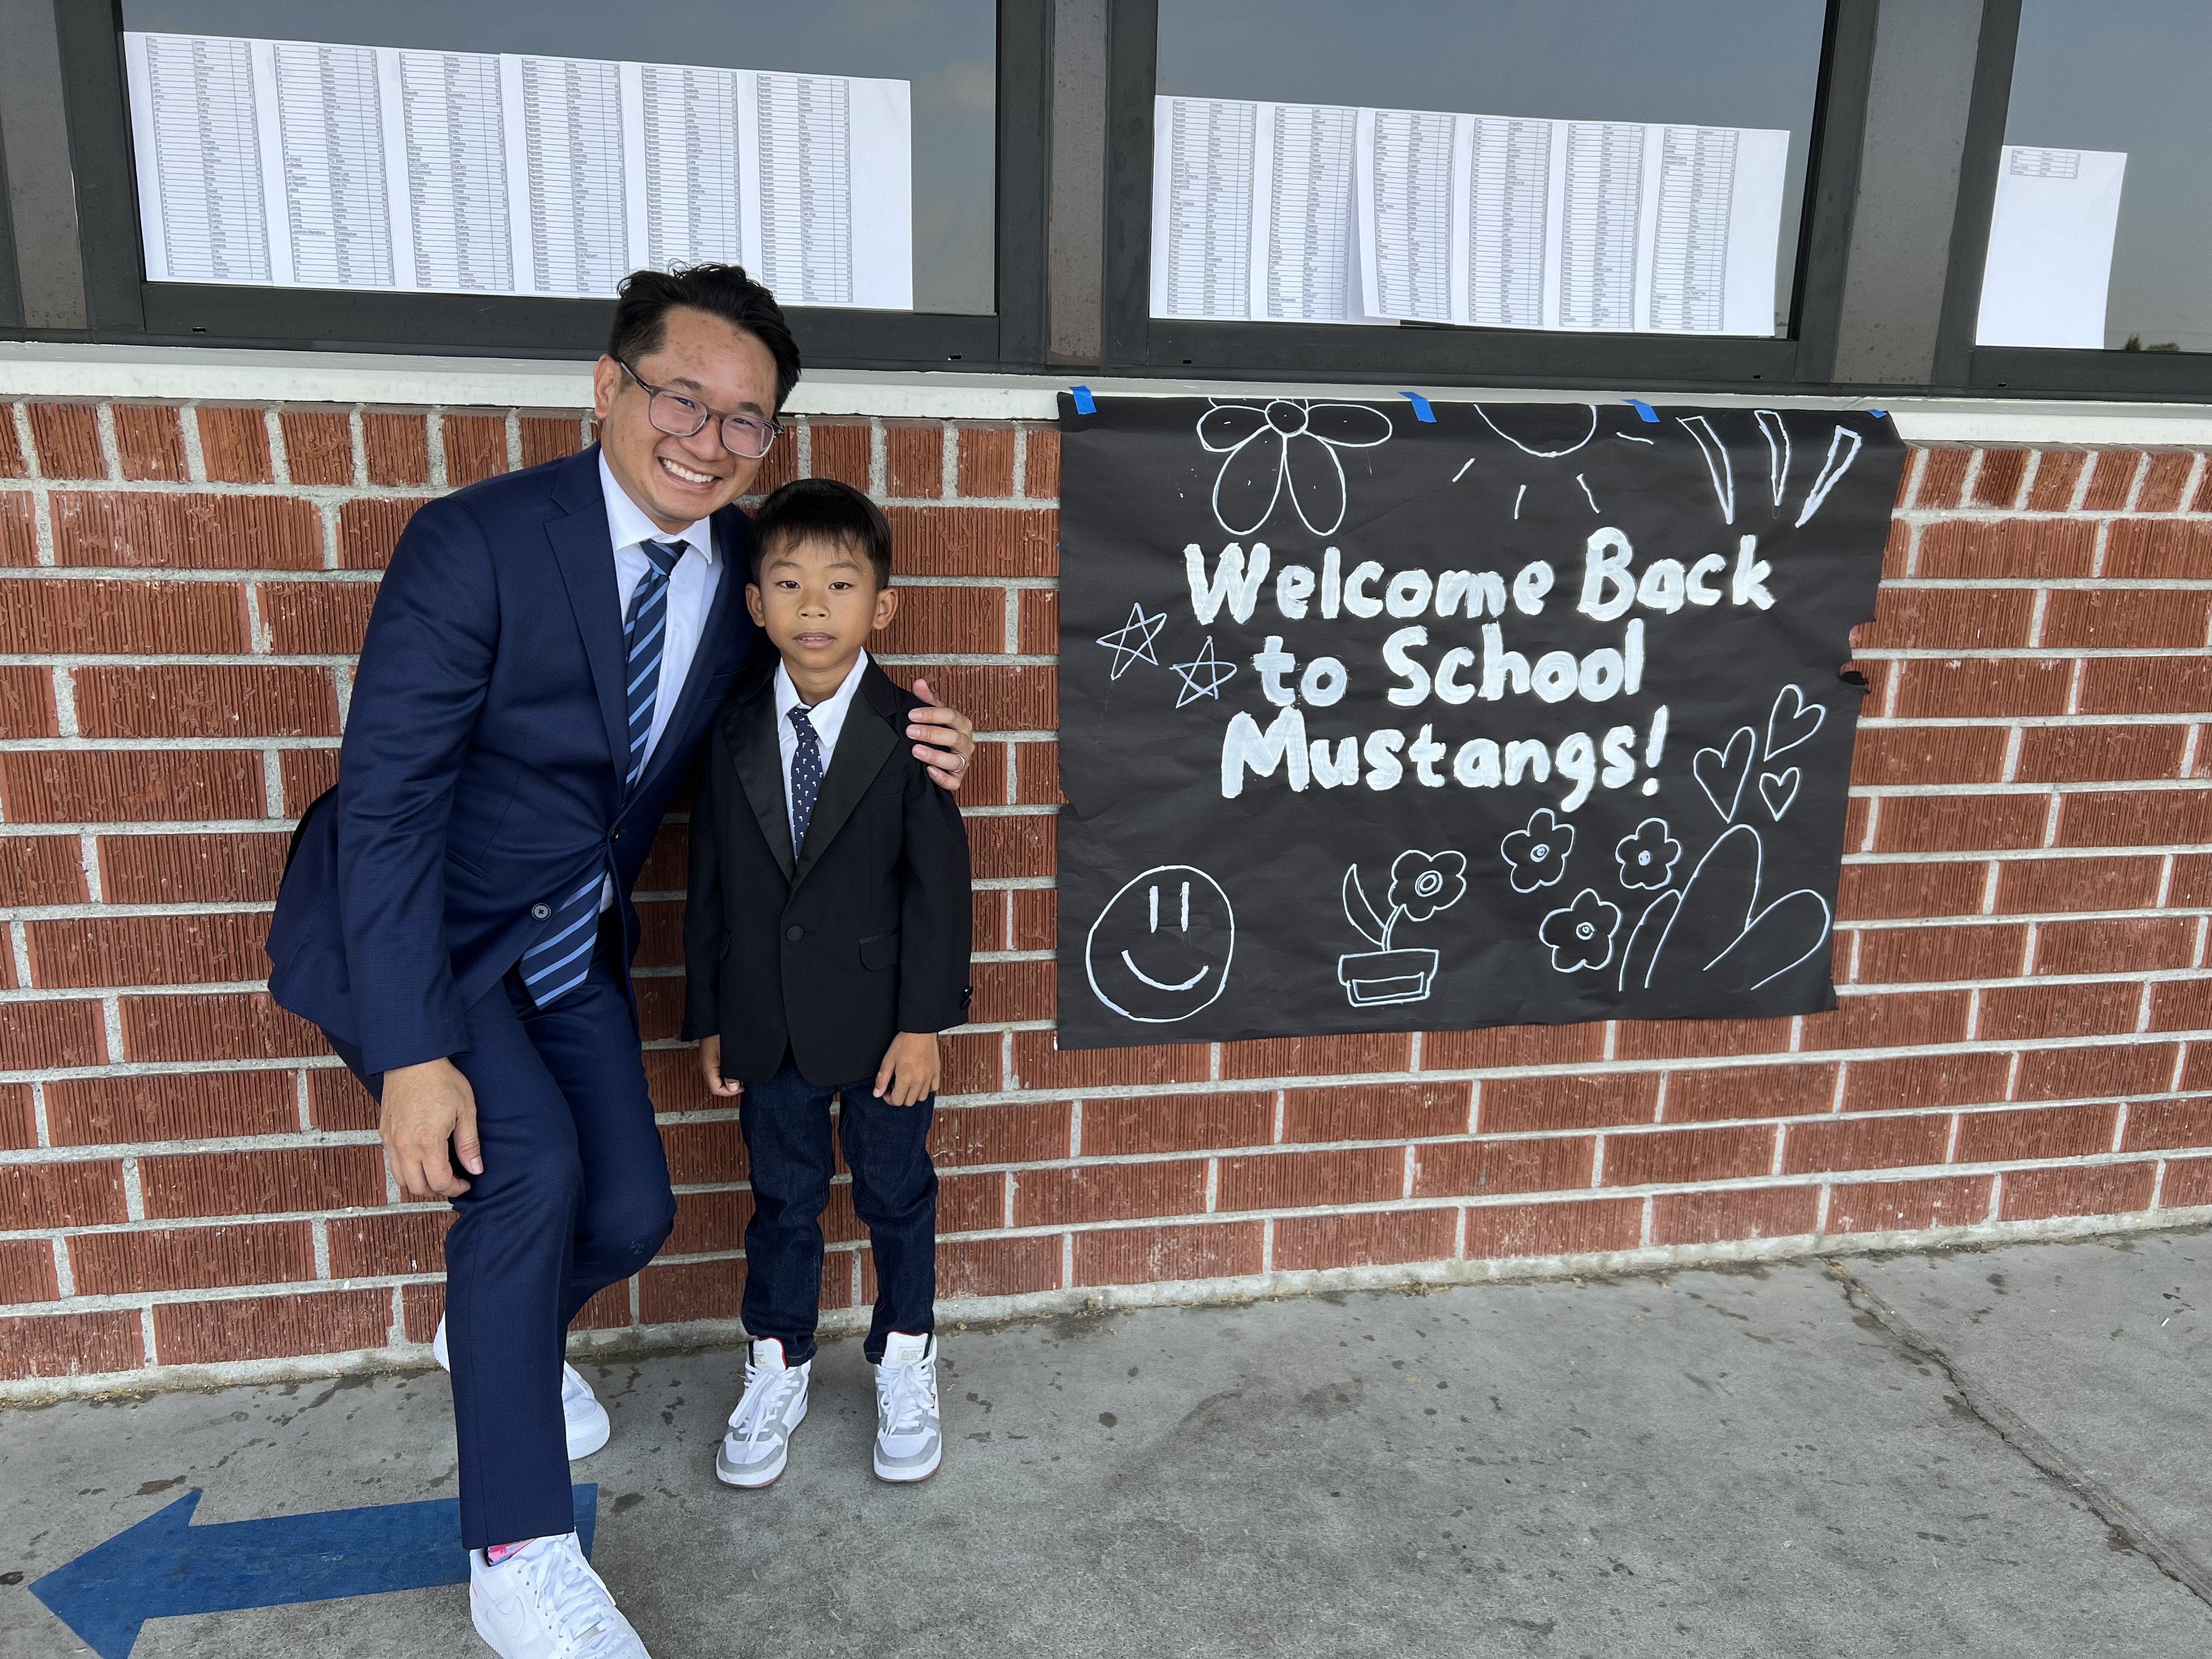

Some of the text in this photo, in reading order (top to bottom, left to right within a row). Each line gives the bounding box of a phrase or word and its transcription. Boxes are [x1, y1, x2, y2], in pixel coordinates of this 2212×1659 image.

[1184, 527, 1776, 624] Welcome Back
[1253, 618, 1644, 706] to School
[1221, 706, 1668, 812] Mustangs!
